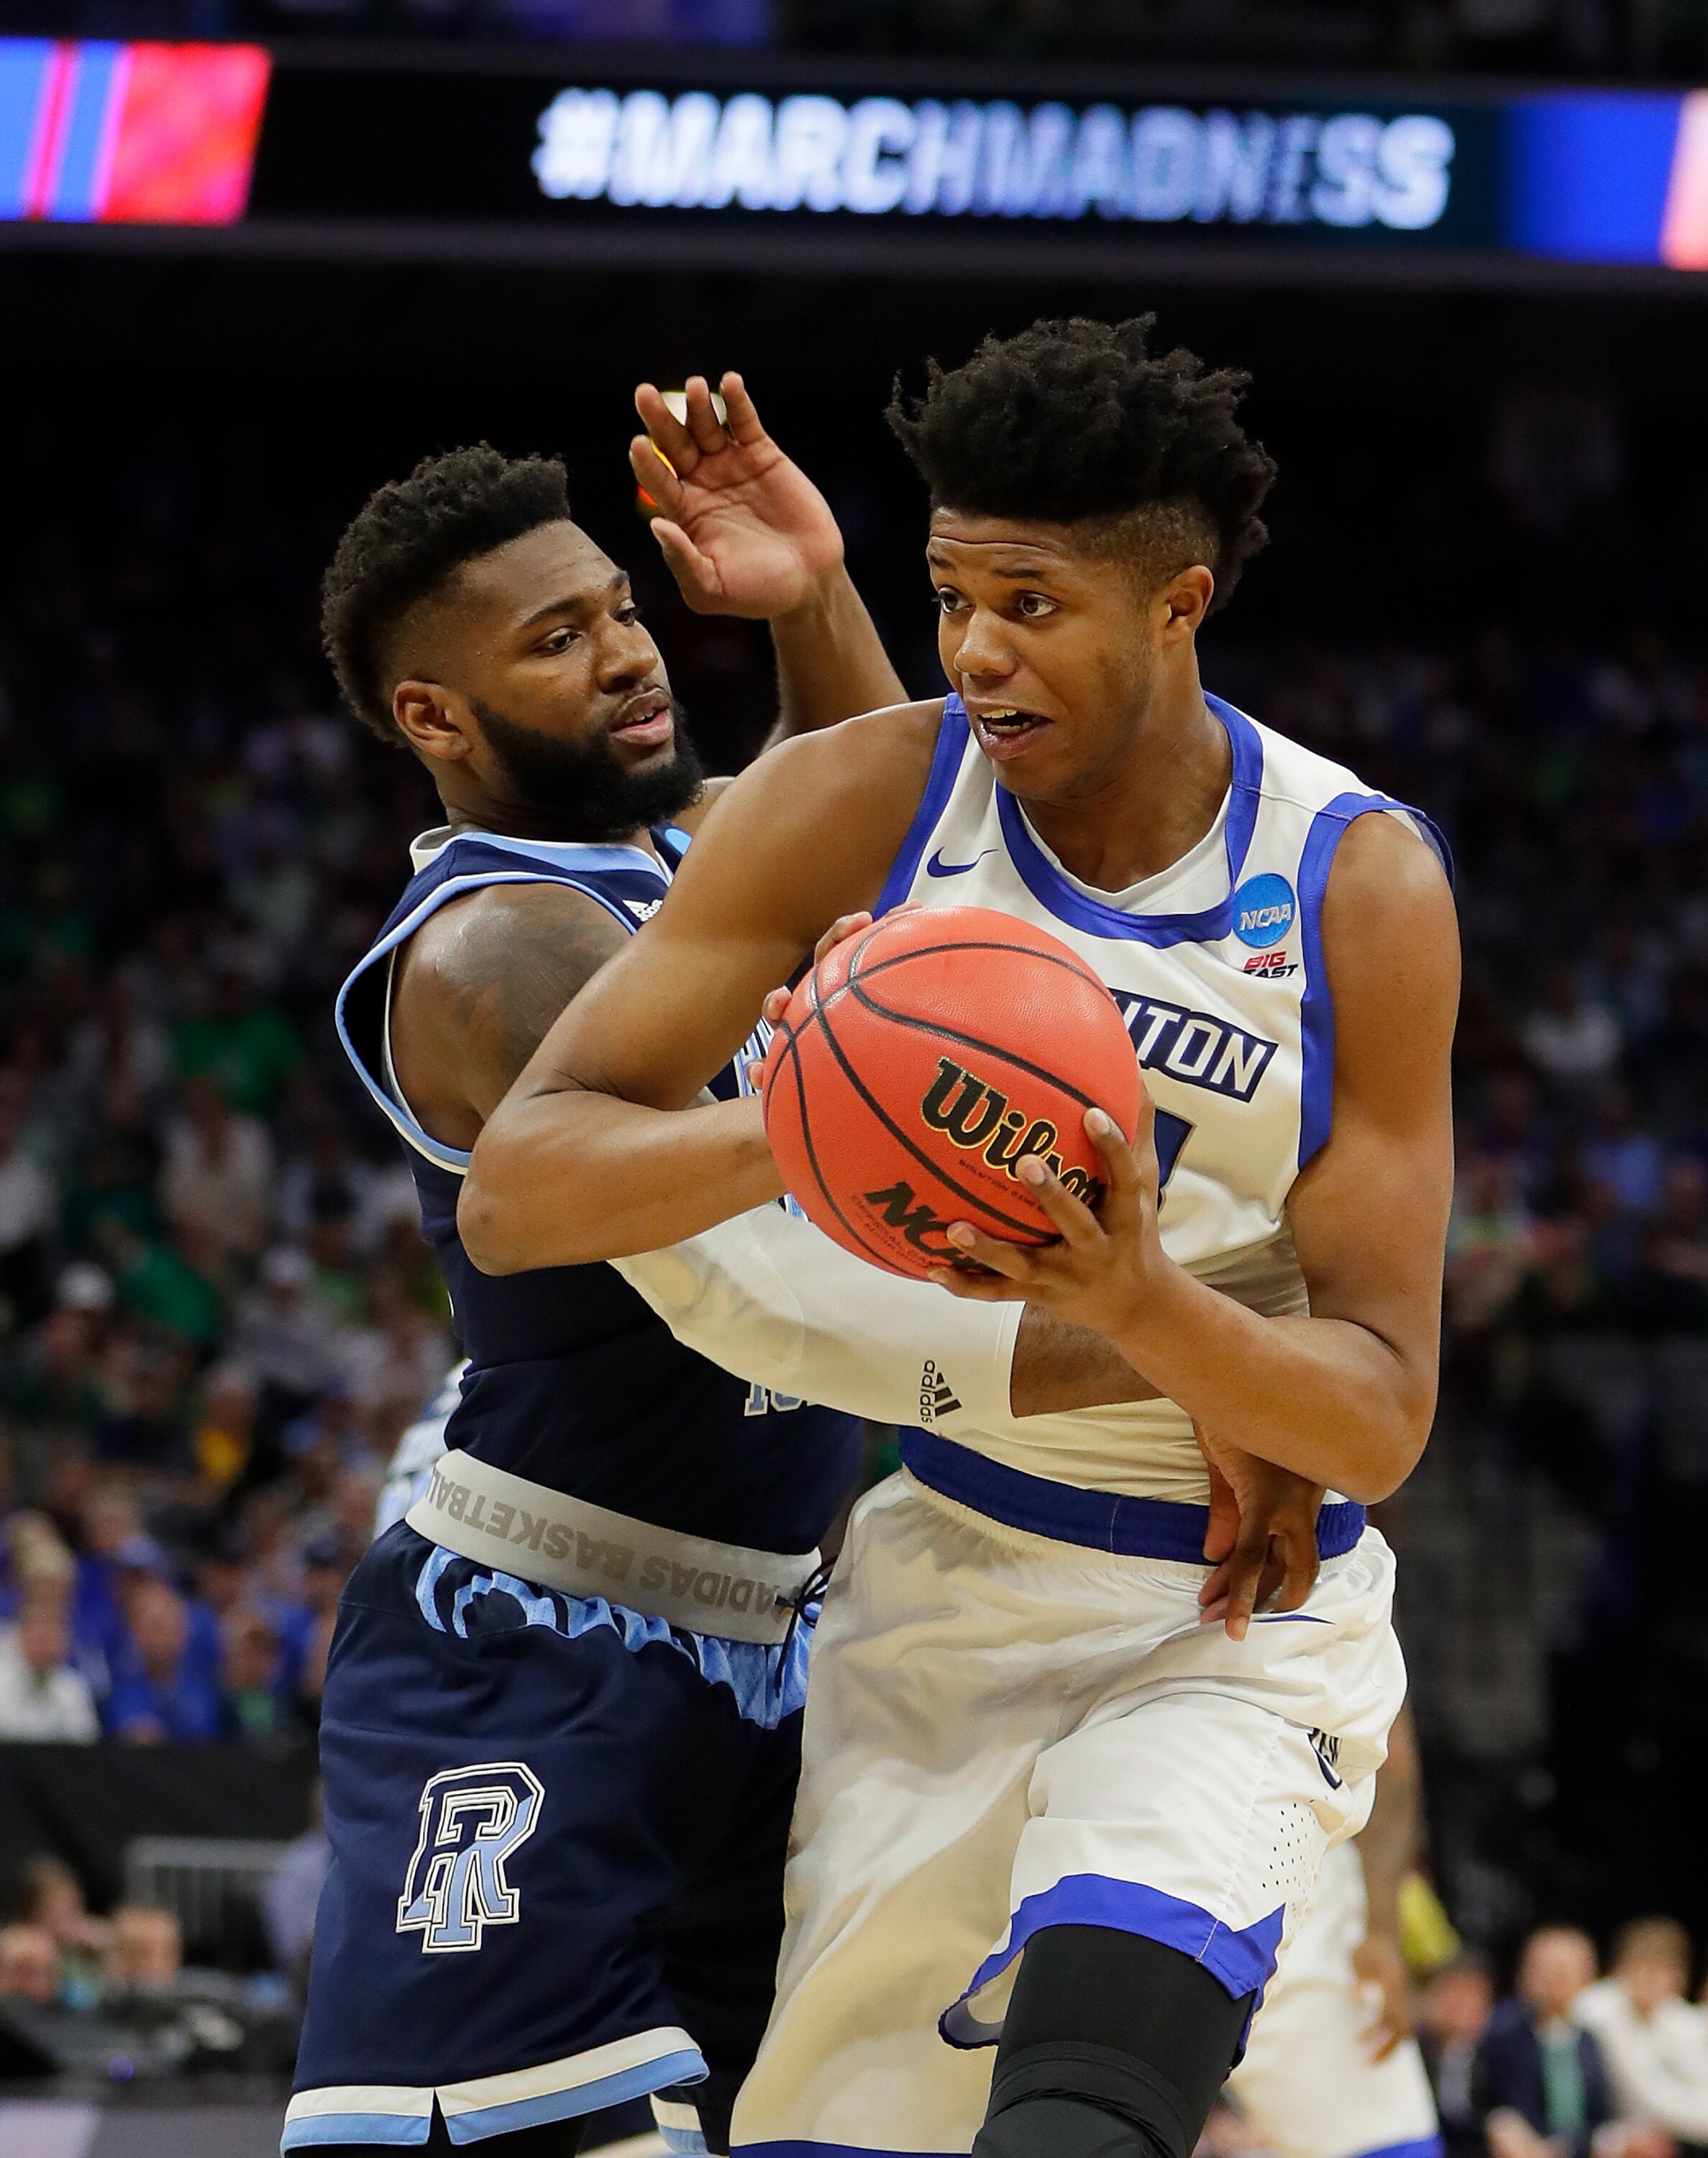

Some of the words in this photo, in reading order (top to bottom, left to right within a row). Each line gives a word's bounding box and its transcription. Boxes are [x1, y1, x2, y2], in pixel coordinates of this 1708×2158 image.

[1239, 903, 1292, 931] NCAA
[1244, 951, 1287, 970] BIG
[920, 1360, 936, 1423] adidas
[639, 1556, 780, 1616] ADIDAS
